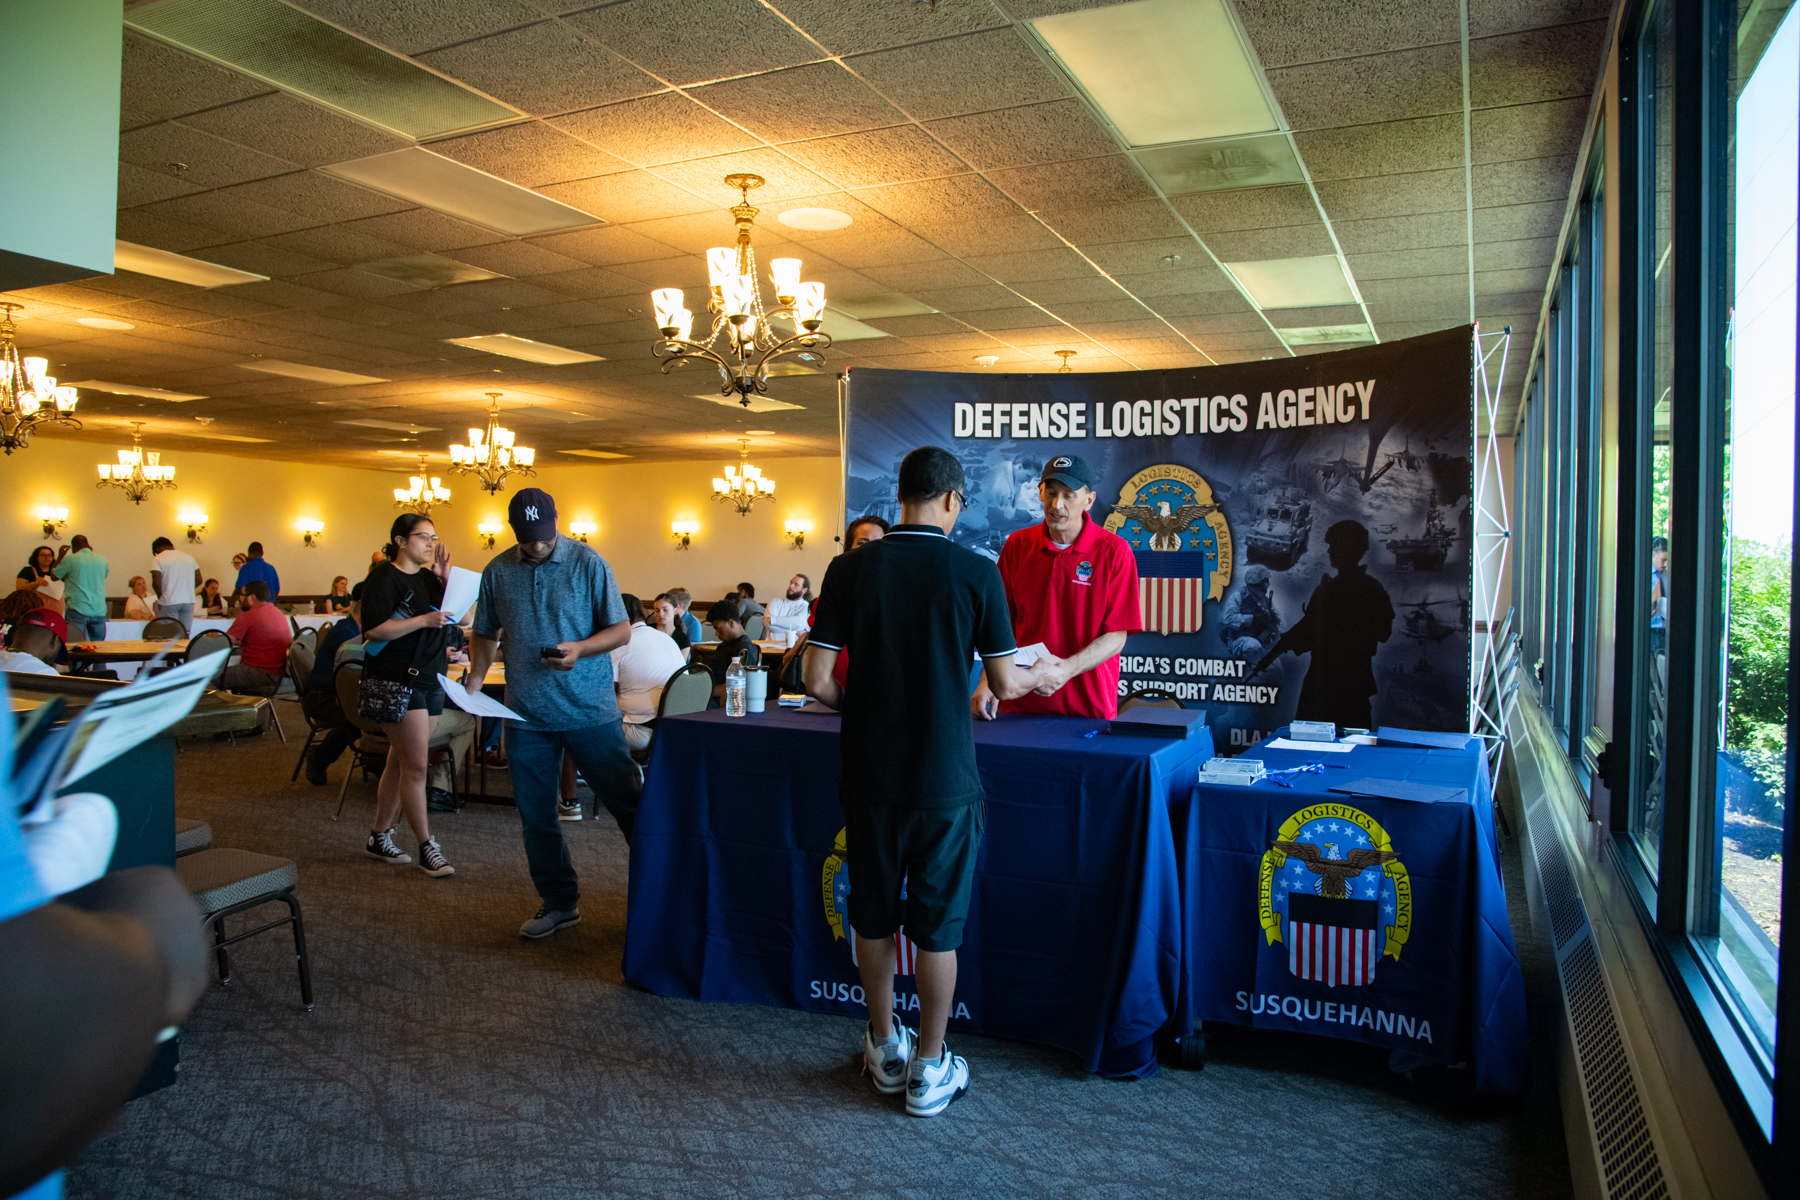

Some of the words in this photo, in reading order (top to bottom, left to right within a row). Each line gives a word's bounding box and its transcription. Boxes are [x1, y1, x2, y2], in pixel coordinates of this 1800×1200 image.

[954, 402, 1087, 439] DEFENSE
[1095, 393, 1248, 438] LOGISTICS
[1255, 379, 1376, 430] AGENCY
[525, 505, 540, 521] NY
[1130, 466, 1202, 489] LOGISTICS
[1214, 521, 1230, 580] AGENCY
[1119, 656, 1171, 675] RICA'S
[1174, 658, 1246, 677] COMBAT
[1132, 680, 1209, 700] SUPPORT
[1212, 685, 1279, 704] AGENCY
[1230, 728, 1262, 747] DLA
[824, 862, 835, 919] DEFENSE
[1260, 855, 1276, 920] DEFENSE
[1292, 805, 1374, 830] LOGISTICS
[1395, 872, 1410, 933] AGENCY
[1235, 990, 1433, 1044] SUSQUEHANNA
